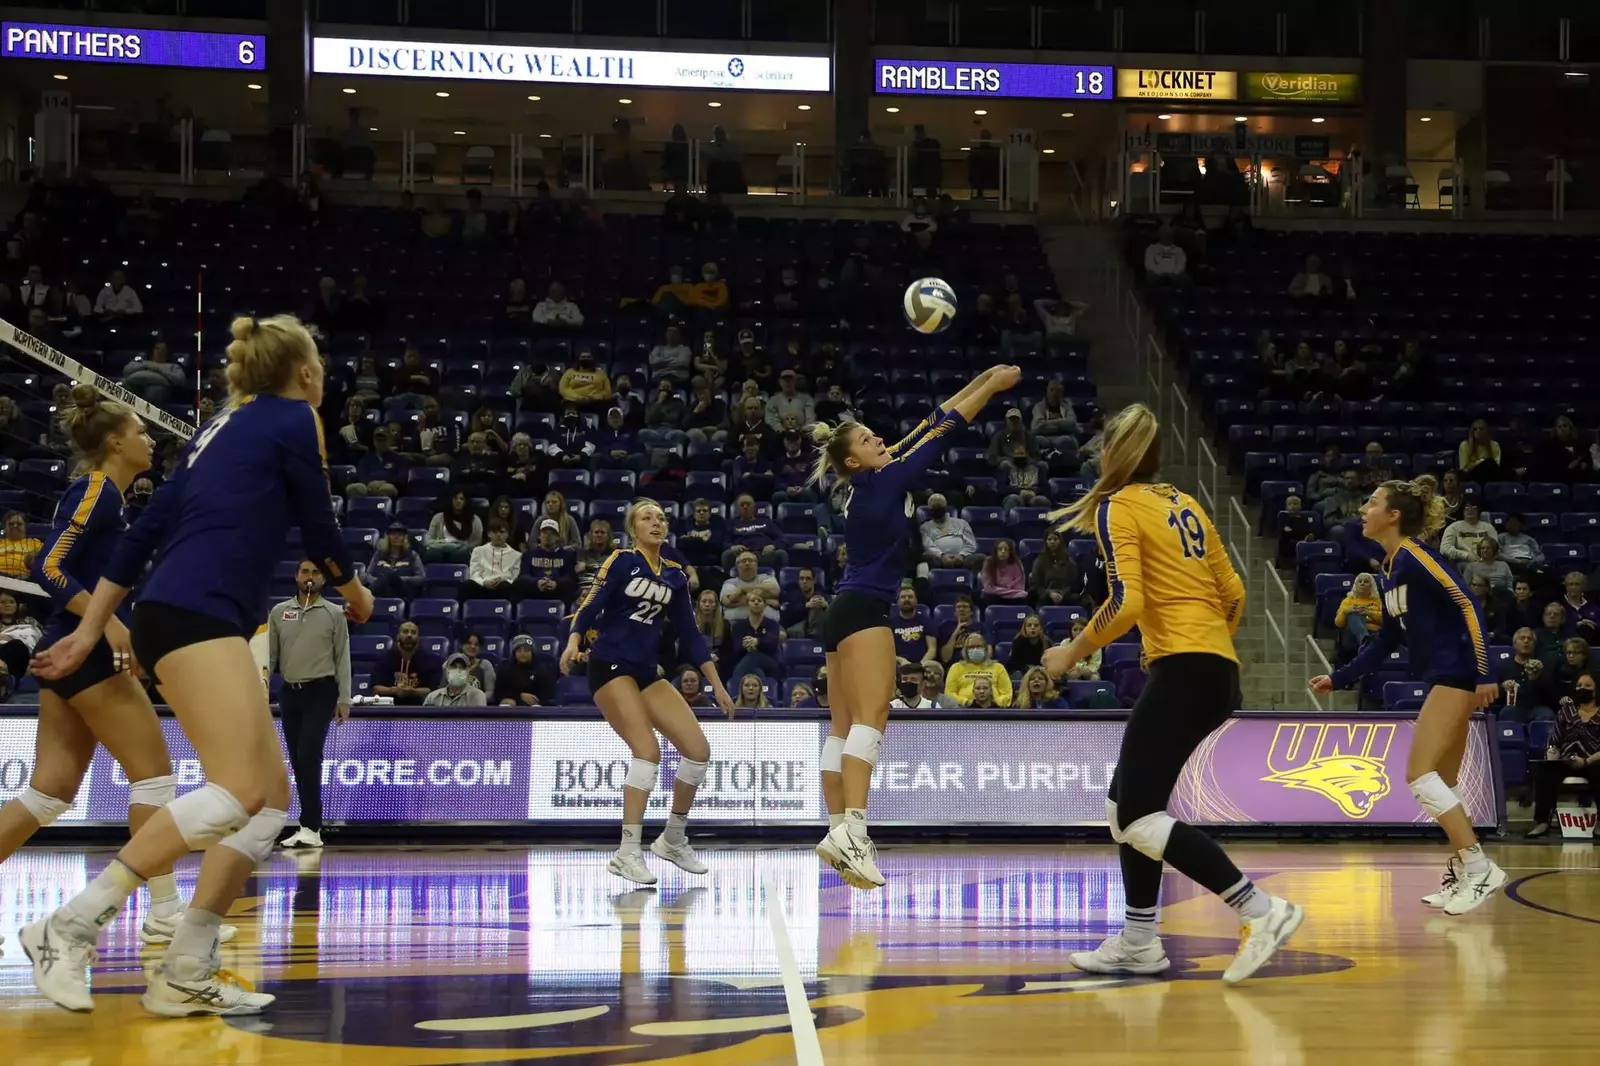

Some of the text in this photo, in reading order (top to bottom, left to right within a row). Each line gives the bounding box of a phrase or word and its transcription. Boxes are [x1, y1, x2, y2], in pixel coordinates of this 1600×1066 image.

[7, 28, 255, 64] PANTHERS 6
[348, 46, 634, 79] DISCERNING WEALTH
[881, 65, 1104, 94] RAMBLERS 18
[1138, 70, 1216, 89] LOCKNET
[1263, 75, 1338, 91] Veridian
[13, 328, 66, 368] NORTHERN IOWA
[94, 374, 137, 408] NORTHERN IOWA
[1168, 507, 1205, 560] 19
[624, 577, 672, 604] UNI
[628, 601, 663, 625] 22
[1267, 723, 1396, 774] UNI
[554, 759, 804, 792] BOO TORE
[692, 796, 755, 807] orthern
